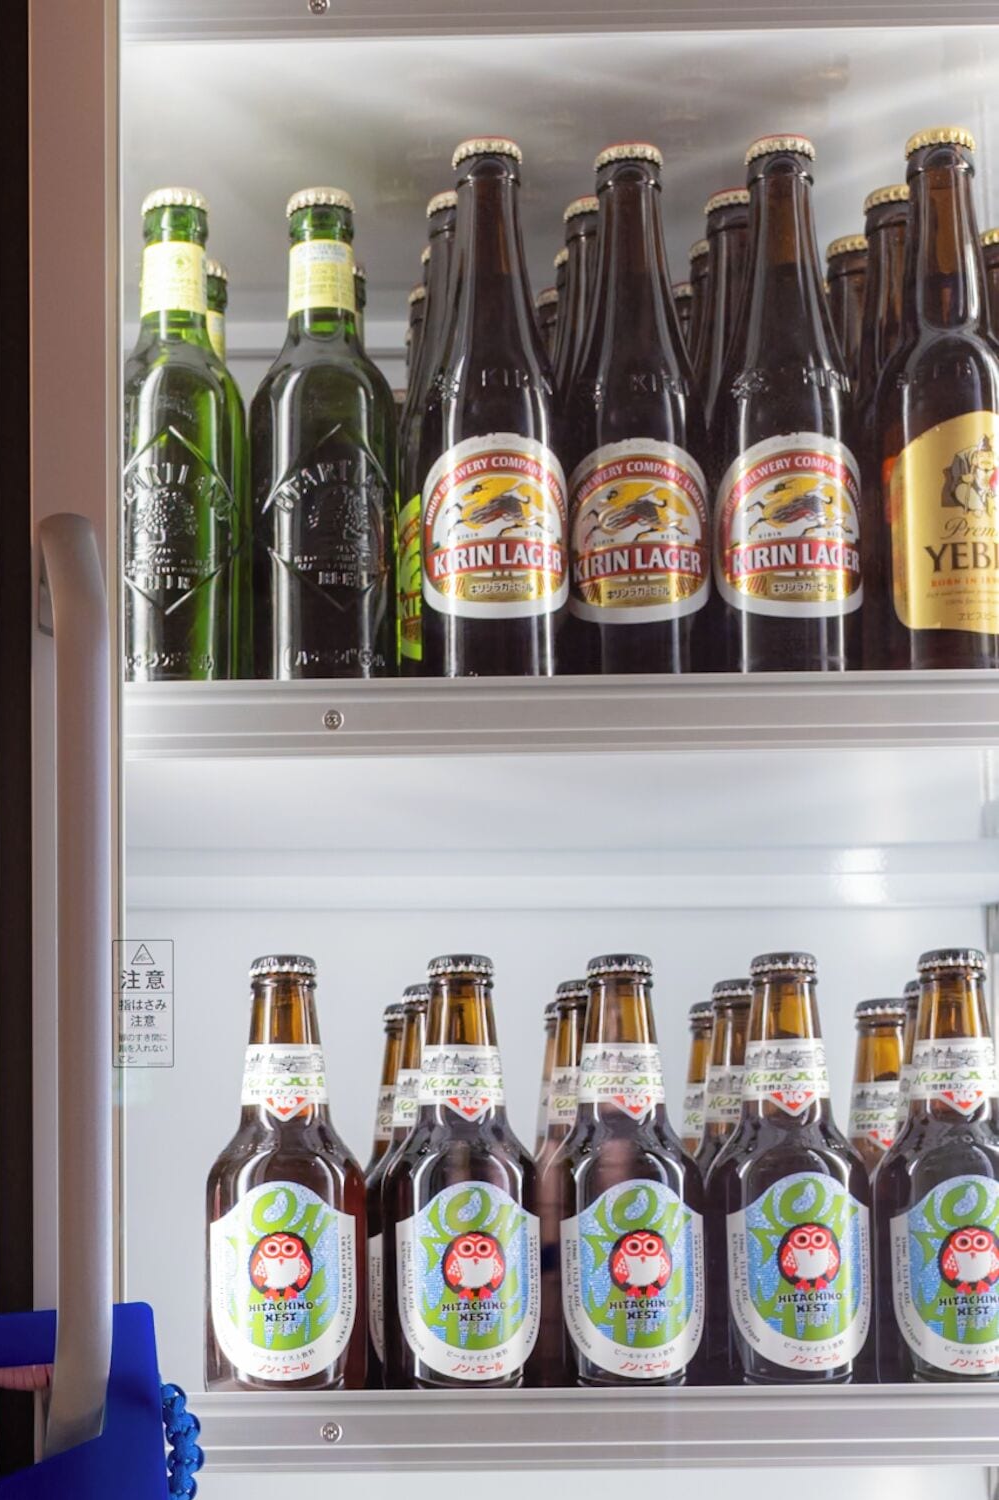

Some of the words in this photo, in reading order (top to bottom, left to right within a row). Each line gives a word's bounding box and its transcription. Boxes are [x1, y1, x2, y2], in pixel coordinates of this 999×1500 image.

[940, 517, 999, 540] Prem
[433, 544, 494, 577] KIRIN
[498, 543, 563, 572] LAGER
[573, 550, 639, 583] KIRIN
[641, 547, 702, 573] LAGER
[732, 545, 798, 576] KIRIN
[802, 544, 860, 573] LAGER
[120, 970, 165, 990] 注意
[130, 1014, 156, 1027] 注意
[778, 1291, 843, 1303] HITACHINO
[938, 1294, 999, 1307] HITACHIN
[249, 1301, 314, 1311] HITACHINO
[441, 1301, 507, 1312] HITACHINO
[608, 1299, 674, 1310] HITACHINO
[795, 1303, 829, 1313] NEST
[626, 1310, 660, 1320] NEST
[957, 1306, 990, 1316] NEST
[265, 1312, 297, 1322] NEST
[459, 1312, 492, 1322] NEST
[788, 1352, 841, 1365] ノン・エール
[257, 1363, 310, 1374] ノン・エール
[451, 1363, 504, 1374] ノン・エール
[619, 1360, 671, 1372] ノン・エール
